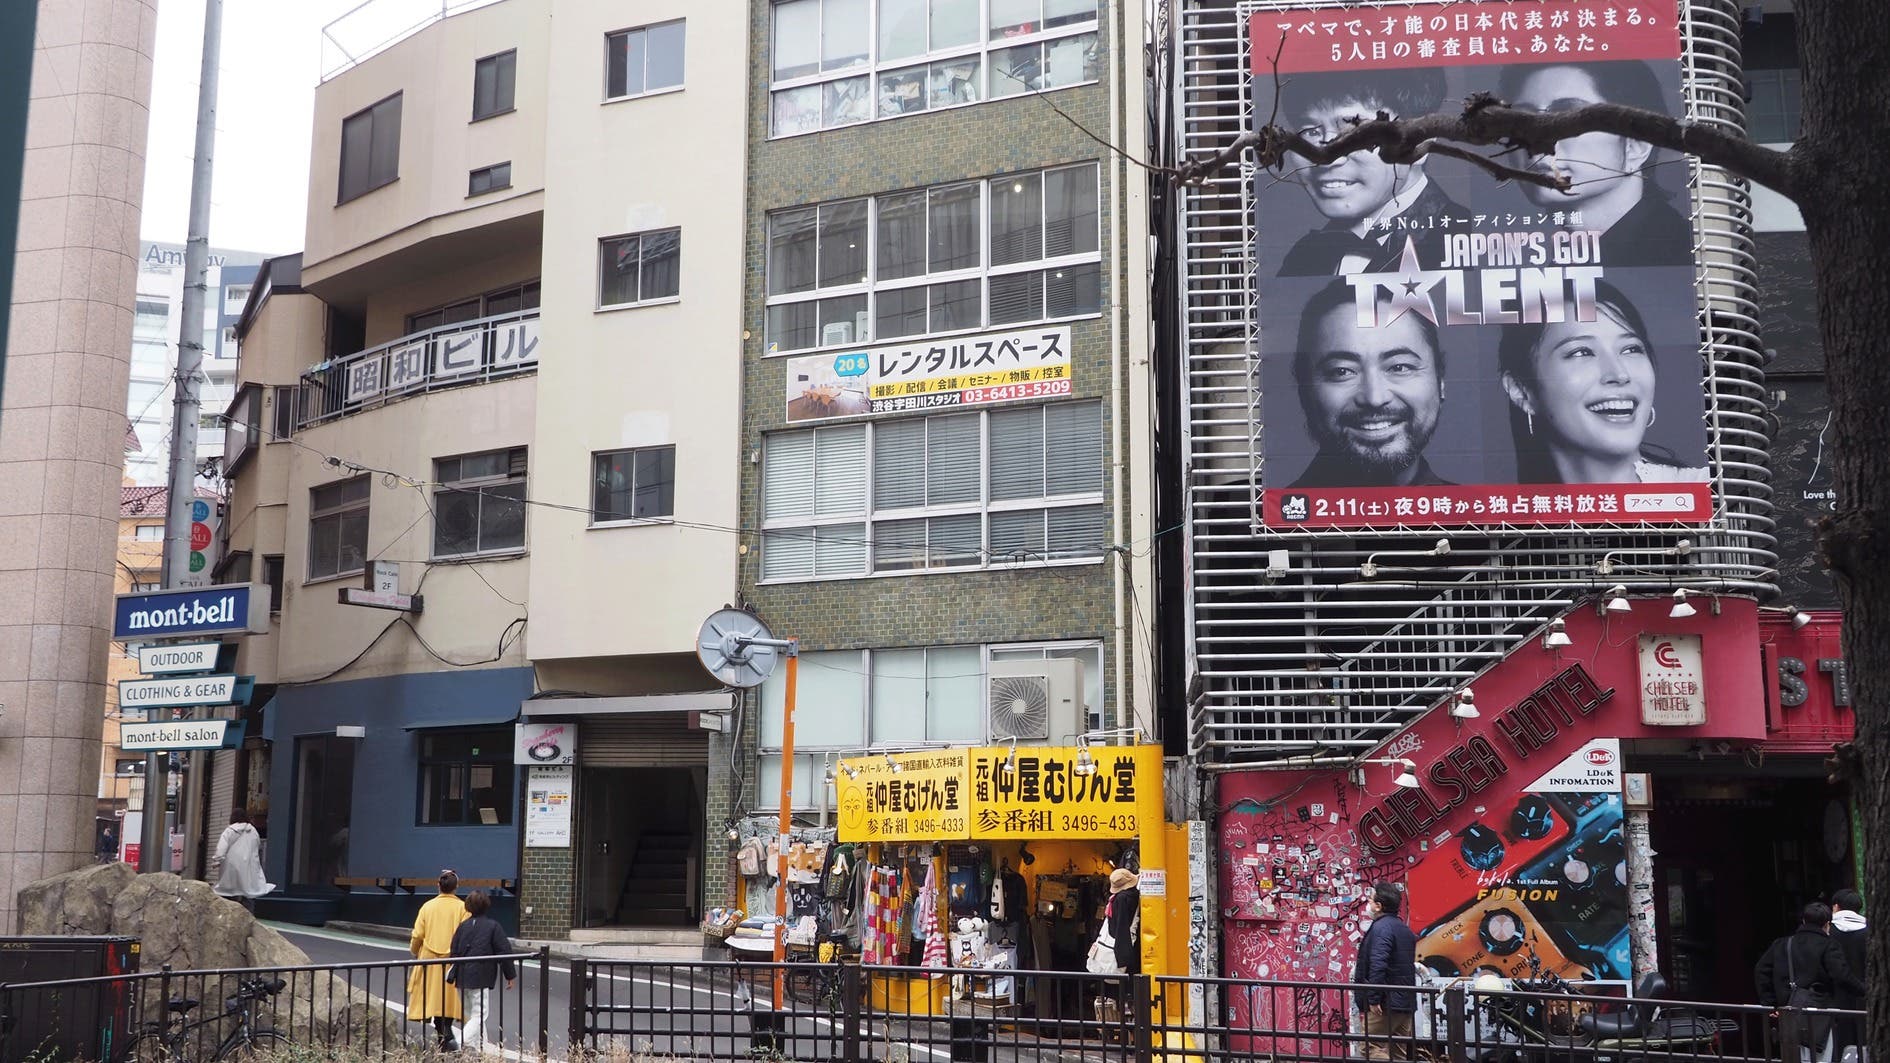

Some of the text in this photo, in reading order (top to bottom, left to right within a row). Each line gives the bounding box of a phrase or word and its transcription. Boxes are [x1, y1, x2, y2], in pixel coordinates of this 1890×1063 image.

[1331, 33, 1611, 62] 5人目の審査員は、あなた。
[1553, 230, 1601, 265] GOT
[1345, 236, 1604, 329] TALENT
[353, 325, 538, 394] 昭和ビル
[879, 333, 1063, 378] レンタルスペース
[906, 382, 926, 393] 配信
[937, 378, 957, 390] 会議
[969, 375, 998, 386] セミナー
[1009, 370, 1031, 382] 物販
[1042, 366, 1064, 379] 控室
[965, 380, 1070, 403] 03-6413-5209
[1631, 496, 1664, 508] アベマ
[1803, 490, 1825, 500] Love
[151, 652, 204, 666] OUTDOOR
[126, 683, 226, 700] CLOTHING & GEAR
[126, 728, 219, 744] mont-bell salon
[1358, 734, 1509, 854] CHELSEA
[1494, 662, 1616, 758] HOTEL
[976, 758, 989, 802] 元祖
[1550, 778, 1614, 786] INFOMATION
[875, 776, 959, 813] 仲屋むげん堂
[868, 818, 964, 835] 参番組 3496-4333
[977, 809, 1054, 832] 参番組
[1477, 889, 1558, 902] FUSION
[1578, 902, 1600, 921] RATE
[1441, 922, 1464, 940] CHECK
[1462, 951, 1486, 970] TONE
